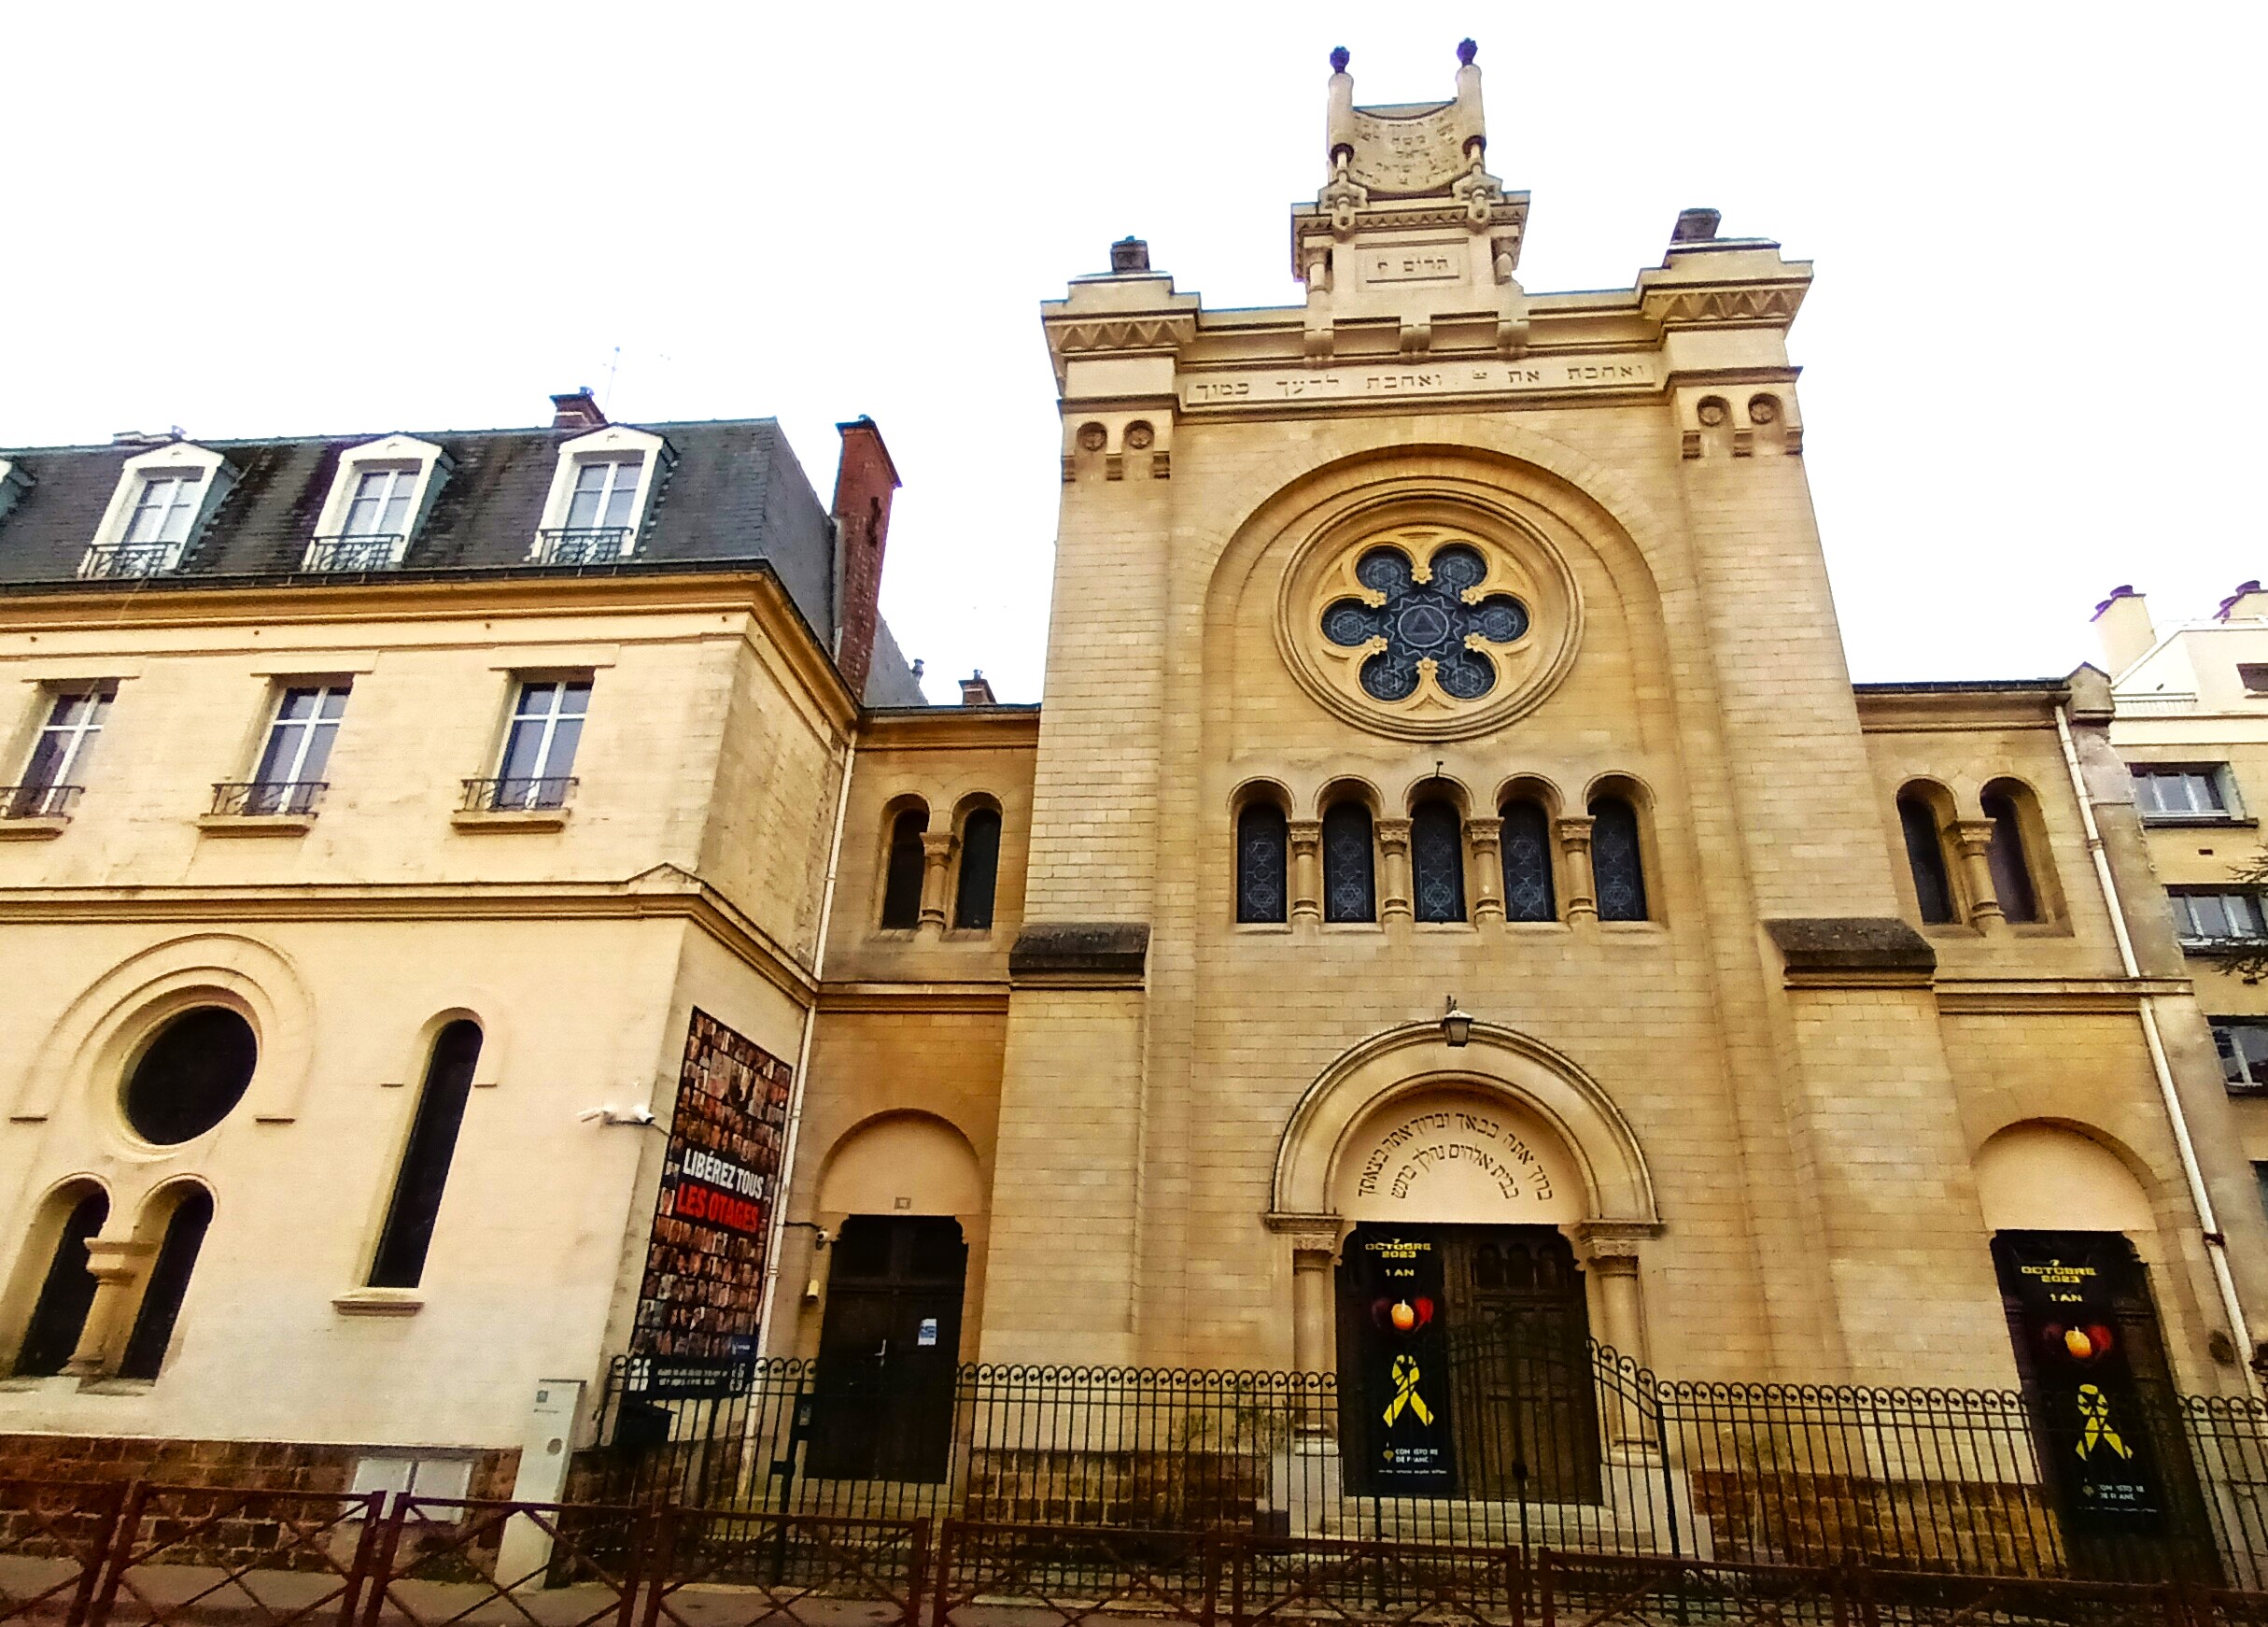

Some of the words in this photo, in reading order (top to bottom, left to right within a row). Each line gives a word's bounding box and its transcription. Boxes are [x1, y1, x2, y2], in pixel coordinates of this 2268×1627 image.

[1507, 370, 1540, 383] את
[1381, 1125, 1414, 1152] אתה
[1455, 1112, 1500, 1139] בבאך
[1448, 1142, 1494, 1170] אלהים
[1501, 1132, 1534, 1165] אתה
[683, 1148, 736, 1190] LIBÉREZ
[736, 1167, 764, 1199] TOUS
[676, 1182, 707, 1218] LES
[708, 1192, 759, 1233] OTAGES
[1365, 1242, 1431, 1251] OCTOBRE
[1394, 1268, 1415, 1277] AN
[2021, 1266, 2097, 1276] OCTOBRE
[2060, 1294, 2083, 1302] AN
